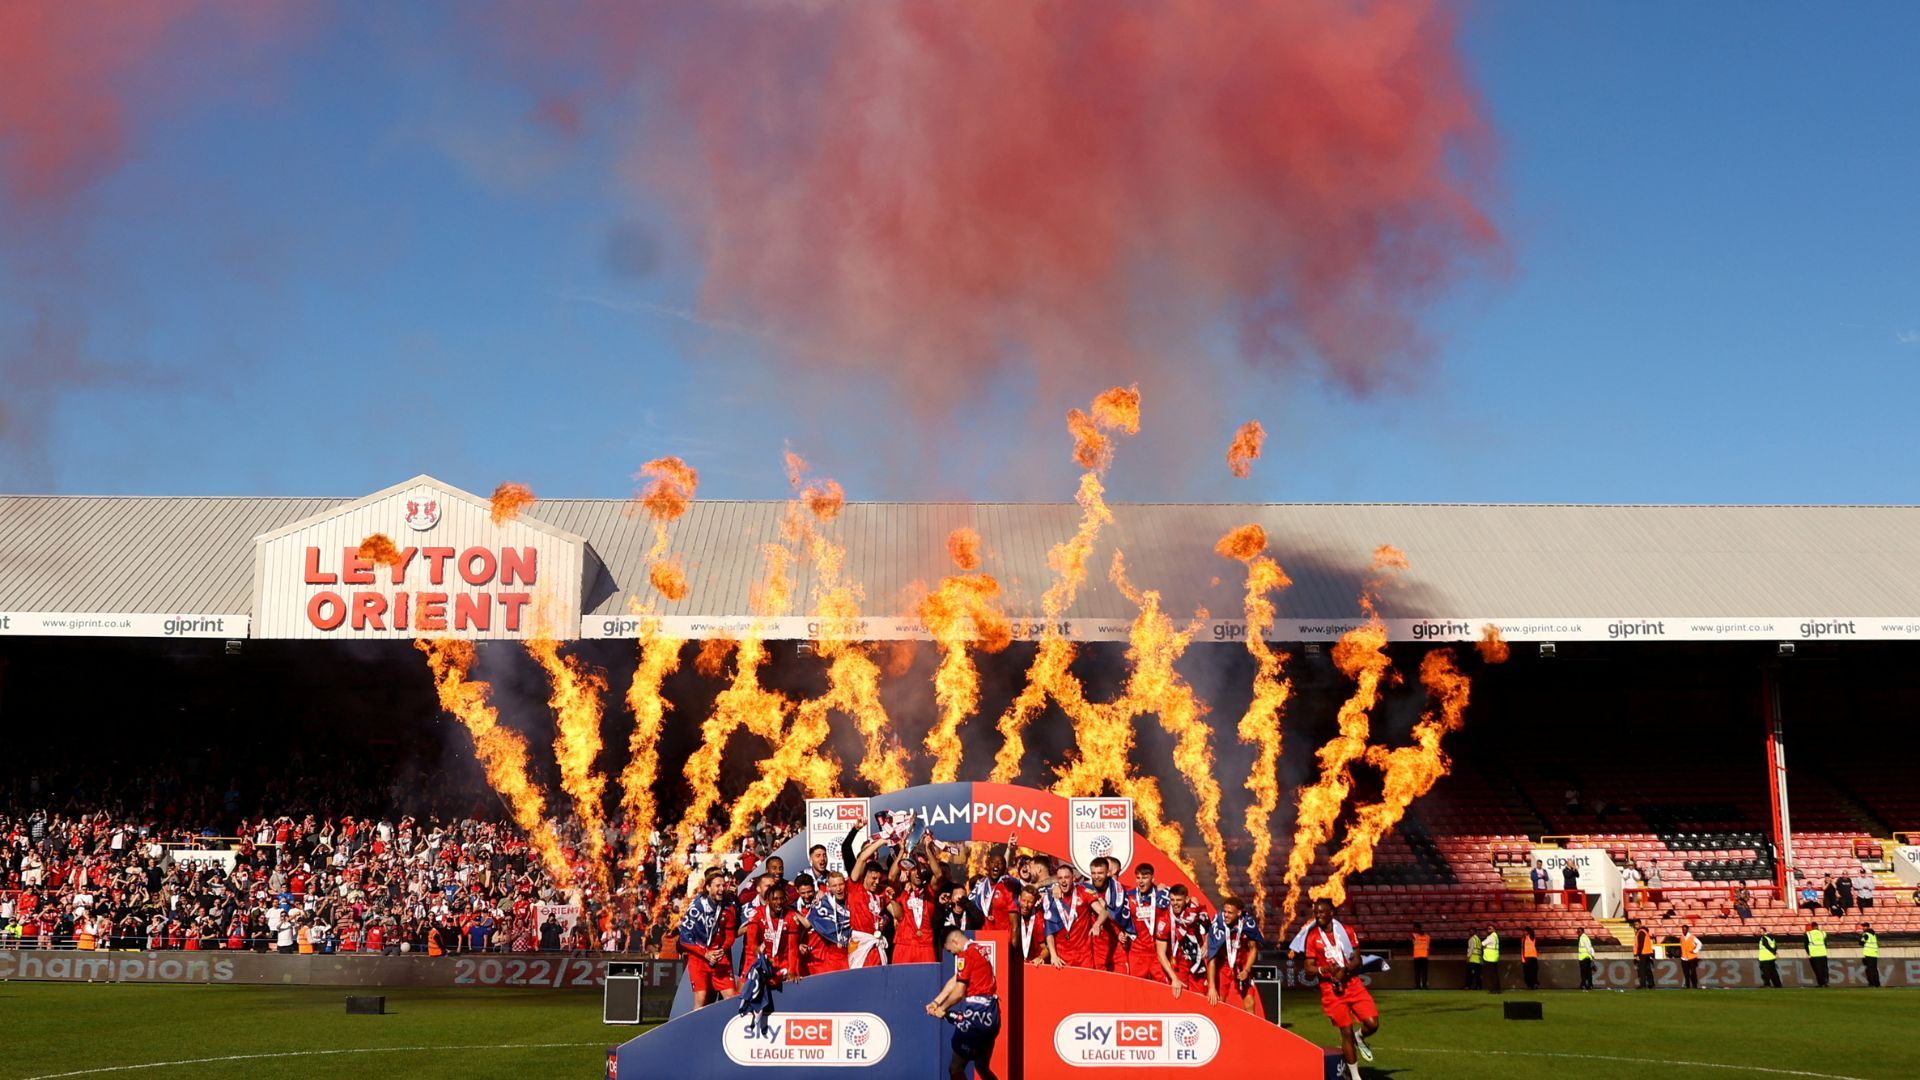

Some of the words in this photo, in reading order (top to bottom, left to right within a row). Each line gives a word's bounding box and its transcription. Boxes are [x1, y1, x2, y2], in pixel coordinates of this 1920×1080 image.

[304, 546, 538, 585] LEYTON
[307, 591, 532, 631] ORIENT
[42, 619, 131, 629] www.giprint.co.uk
[164, 616, 224, 635] giprint
[1412, 620, 1470, 639] giprint
[1608, 620, 1665, 638] giprint
[1691, 623, 1775, 633] www.giprint.co.uk
[1800, 619, 1856, 638] giprint
[812, 806, 835, 819] sky
[839, 805, 862, 817] bet
[895, 802, 1052, 833] HAMPIONS
[1075, 804, 1097, 818] sky
[1102, 805, 1124, 816] bet
[813, 823, 843, 831] LEAGUE
[845, 823, 858, 831] TW
[1076, 822, 1105, 830] LEAGUE
[1108, 822, 1126, 830] TWO
[830, 862, 845, 872] EF
[1547, 855, 1589, 869] gipint
[0, 952, 234, 981] Champions
[744, 1022, 781, 1043] sky
[790, 1021, 828, 1040] bet
[1075, 1021, 1112, 1045] sky
[1121, 1022, 1158, 1041] bet
[750, 1049, 795, 1059] LEAGUE
[800, 1049, 825, 1059] TWO
[846, 1049, 867, 1059] EFL
[1082, 1050, 1126, 1060] LEAGUE
[1131, 1050, 1155, 1060] TWO
[1177, 1050, 1197, 1060] EFL
